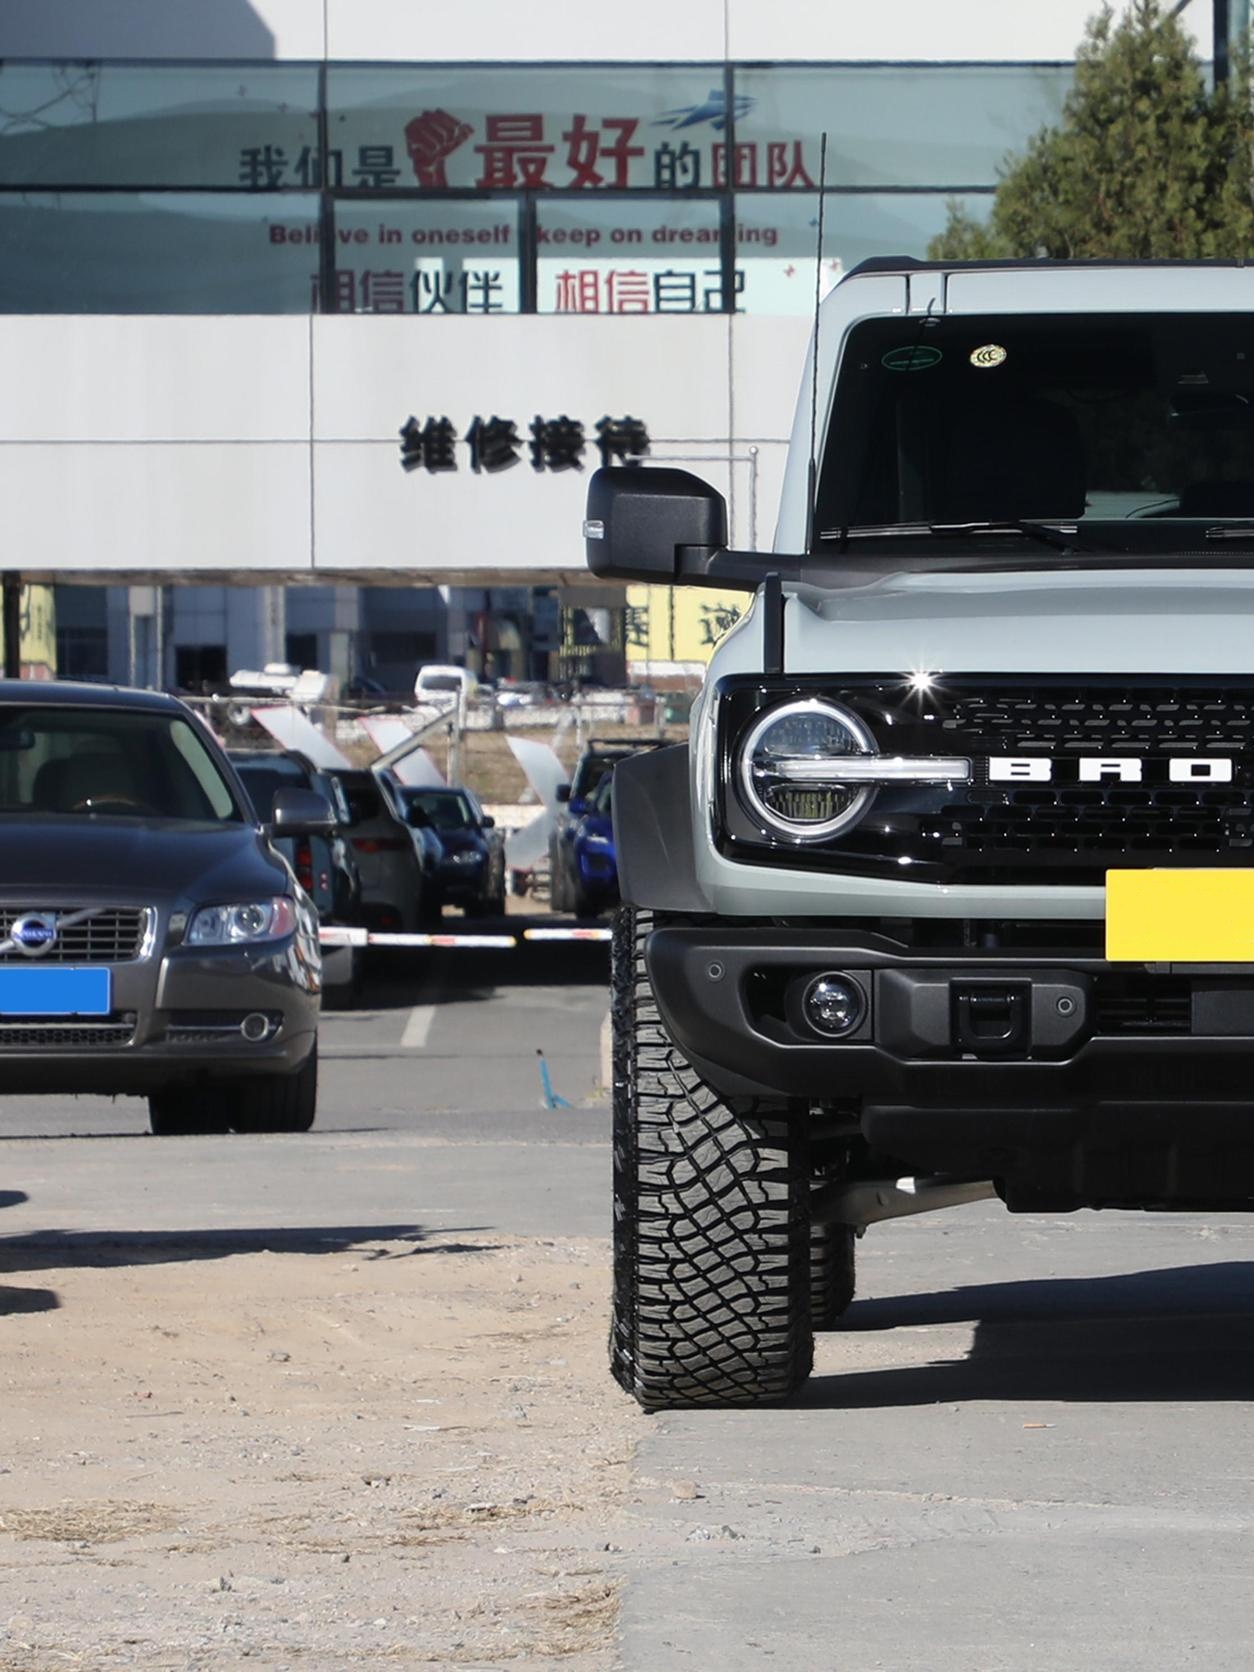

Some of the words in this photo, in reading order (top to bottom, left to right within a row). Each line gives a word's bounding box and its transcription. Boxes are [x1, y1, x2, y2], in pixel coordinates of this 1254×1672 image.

[379, 224, 402, 244] in
[411, 223, 511, 245] oneself
[610, 226, 643, 244] on
[555, 269, 746, 314] 相信自己
[398, 414, 655, 474] 维修接待
